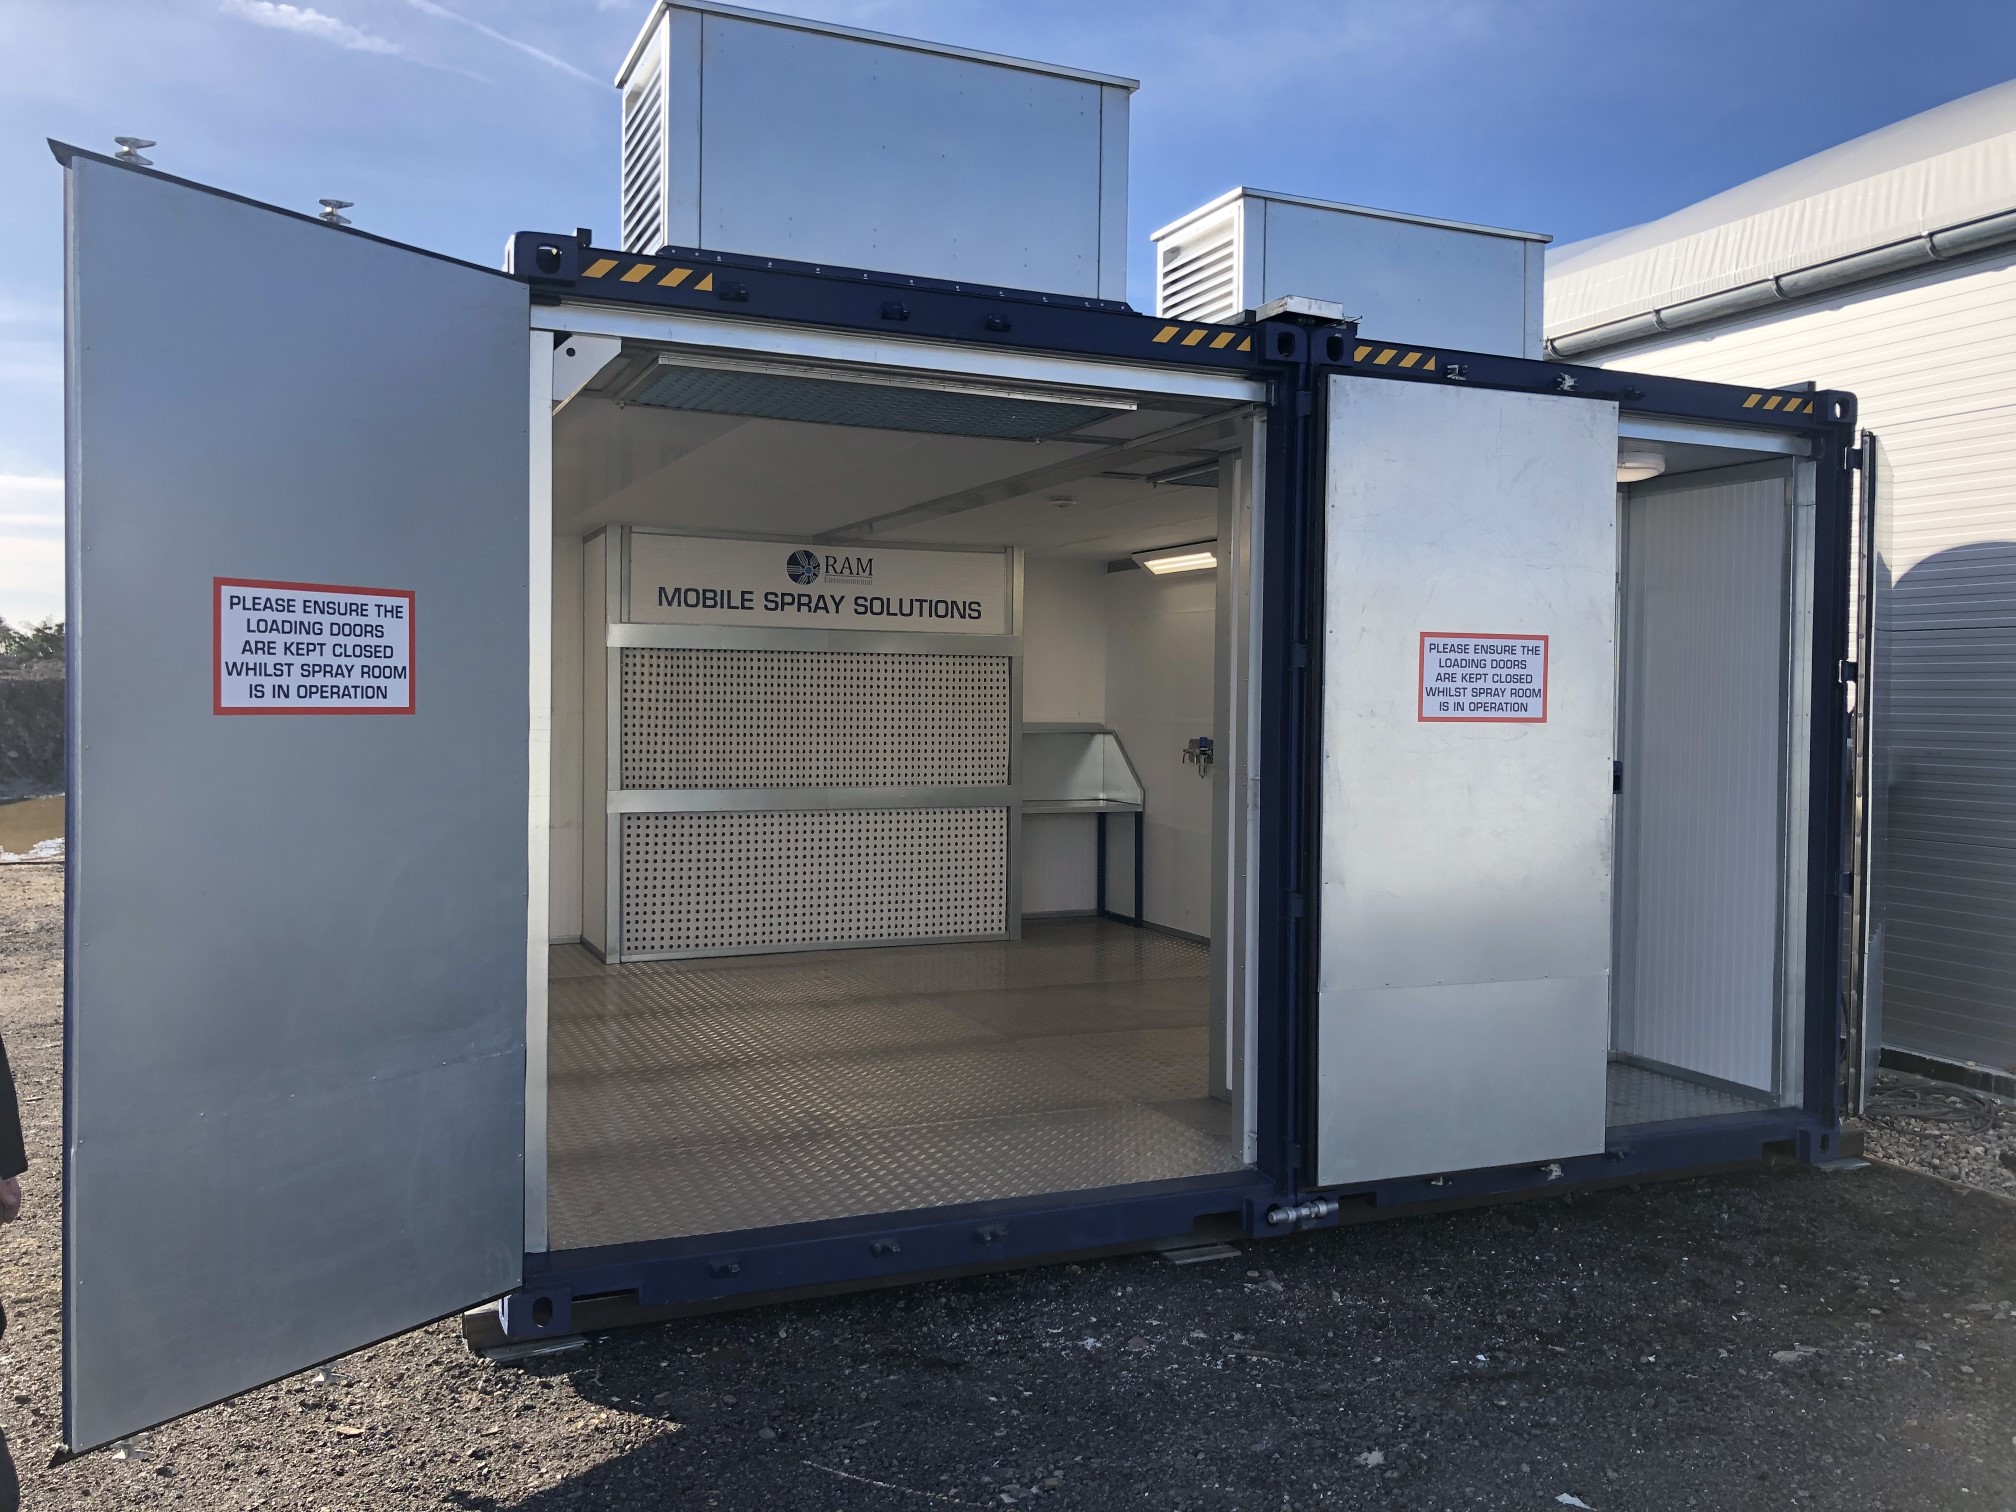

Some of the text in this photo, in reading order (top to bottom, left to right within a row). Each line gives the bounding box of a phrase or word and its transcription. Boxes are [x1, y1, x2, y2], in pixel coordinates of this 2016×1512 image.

[824, 555, 874, 576] RAM
[824, 576, 873, 585] Environmental
[229, 594, 404, 620] PLEASE ENSURE THE
[658, 586, 982, 620] MOBILE SPRAY SOLUTIONS
[246, 617, 385, 639] LOADING DOORS
[240, 639, 394, 659] ARE KEPT CLOSED
[1428, 642, 1541, 656] PLEASE ENSURE THE
[224, 661, 407, 680] WHILST SPRAY ROOM
[1438, 657, 1527, 670] LOADING DOORS
[1434, 672, 1533, 684] ARE KEPT CLOSED
[248, 683, 388, 700] IS IN OPERATION
[1424, 686, 1542, 699] WHILST SPRAY ROOM
[1438, 701, 1528, 713] IS IN OPERATION
